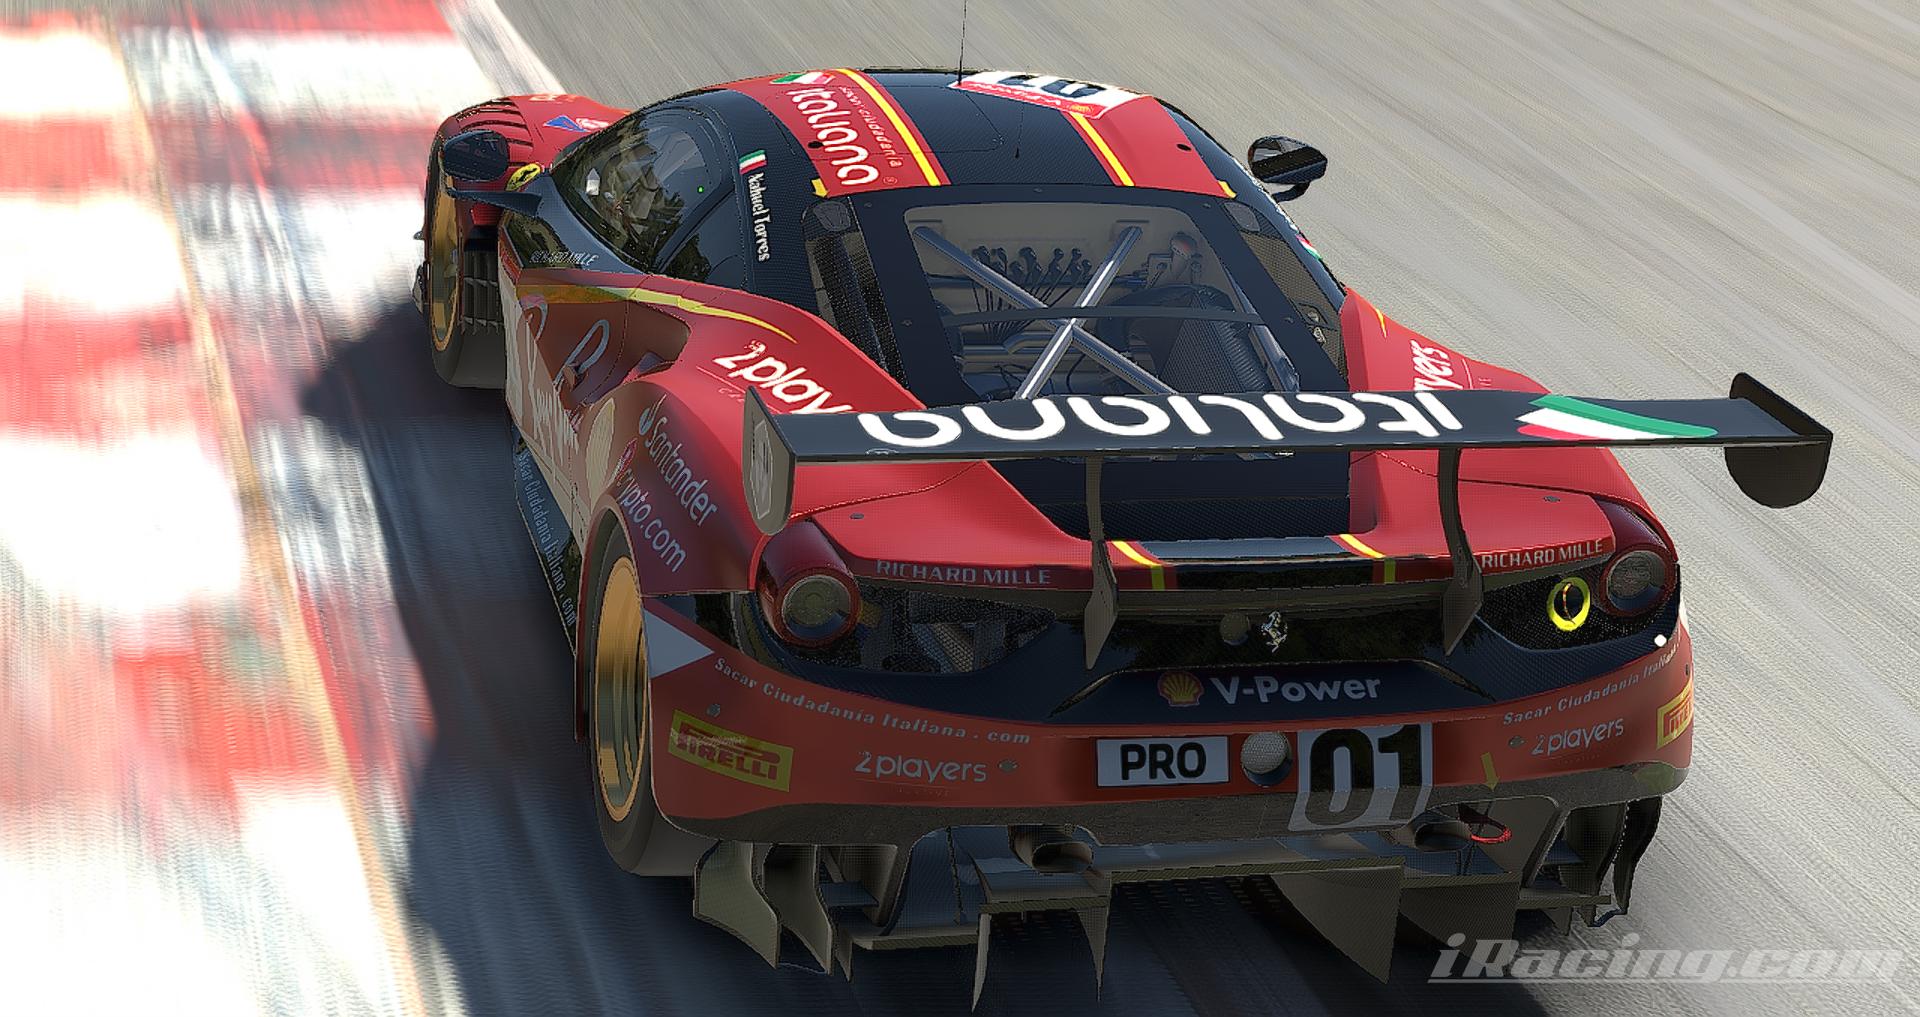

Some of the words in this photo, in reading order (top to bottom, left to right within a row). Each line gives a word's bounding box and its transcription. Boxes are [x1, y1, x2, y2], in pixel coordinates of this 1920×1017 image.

[748, 172, 770, 216] Nahuel
[754, 214, 771, 262] Torres
[644, 416, 718, 527] Santander
[876, 559, 978, 583] RICHARD
[983, 568, 1052, 585] MILLE
[1481, 549, 1555, 569] RICHARD
[1558, 538, 1603, 561] MILLE
[714, 657, 759, 689] Sacar
[882, 713, 967, 739] Italiana
[1210, 674, 1382, 705] V-Power
[1503, 704, 1552, 725] Sacar
[676, 720, 781, 781] PIRELLI
[1531, 717, 1625, 756] 2players
[855, 750, 988, 784] 2players
[1120, 741, 1208, 781] PRO
[1304, 723, 1423, 826] 01
